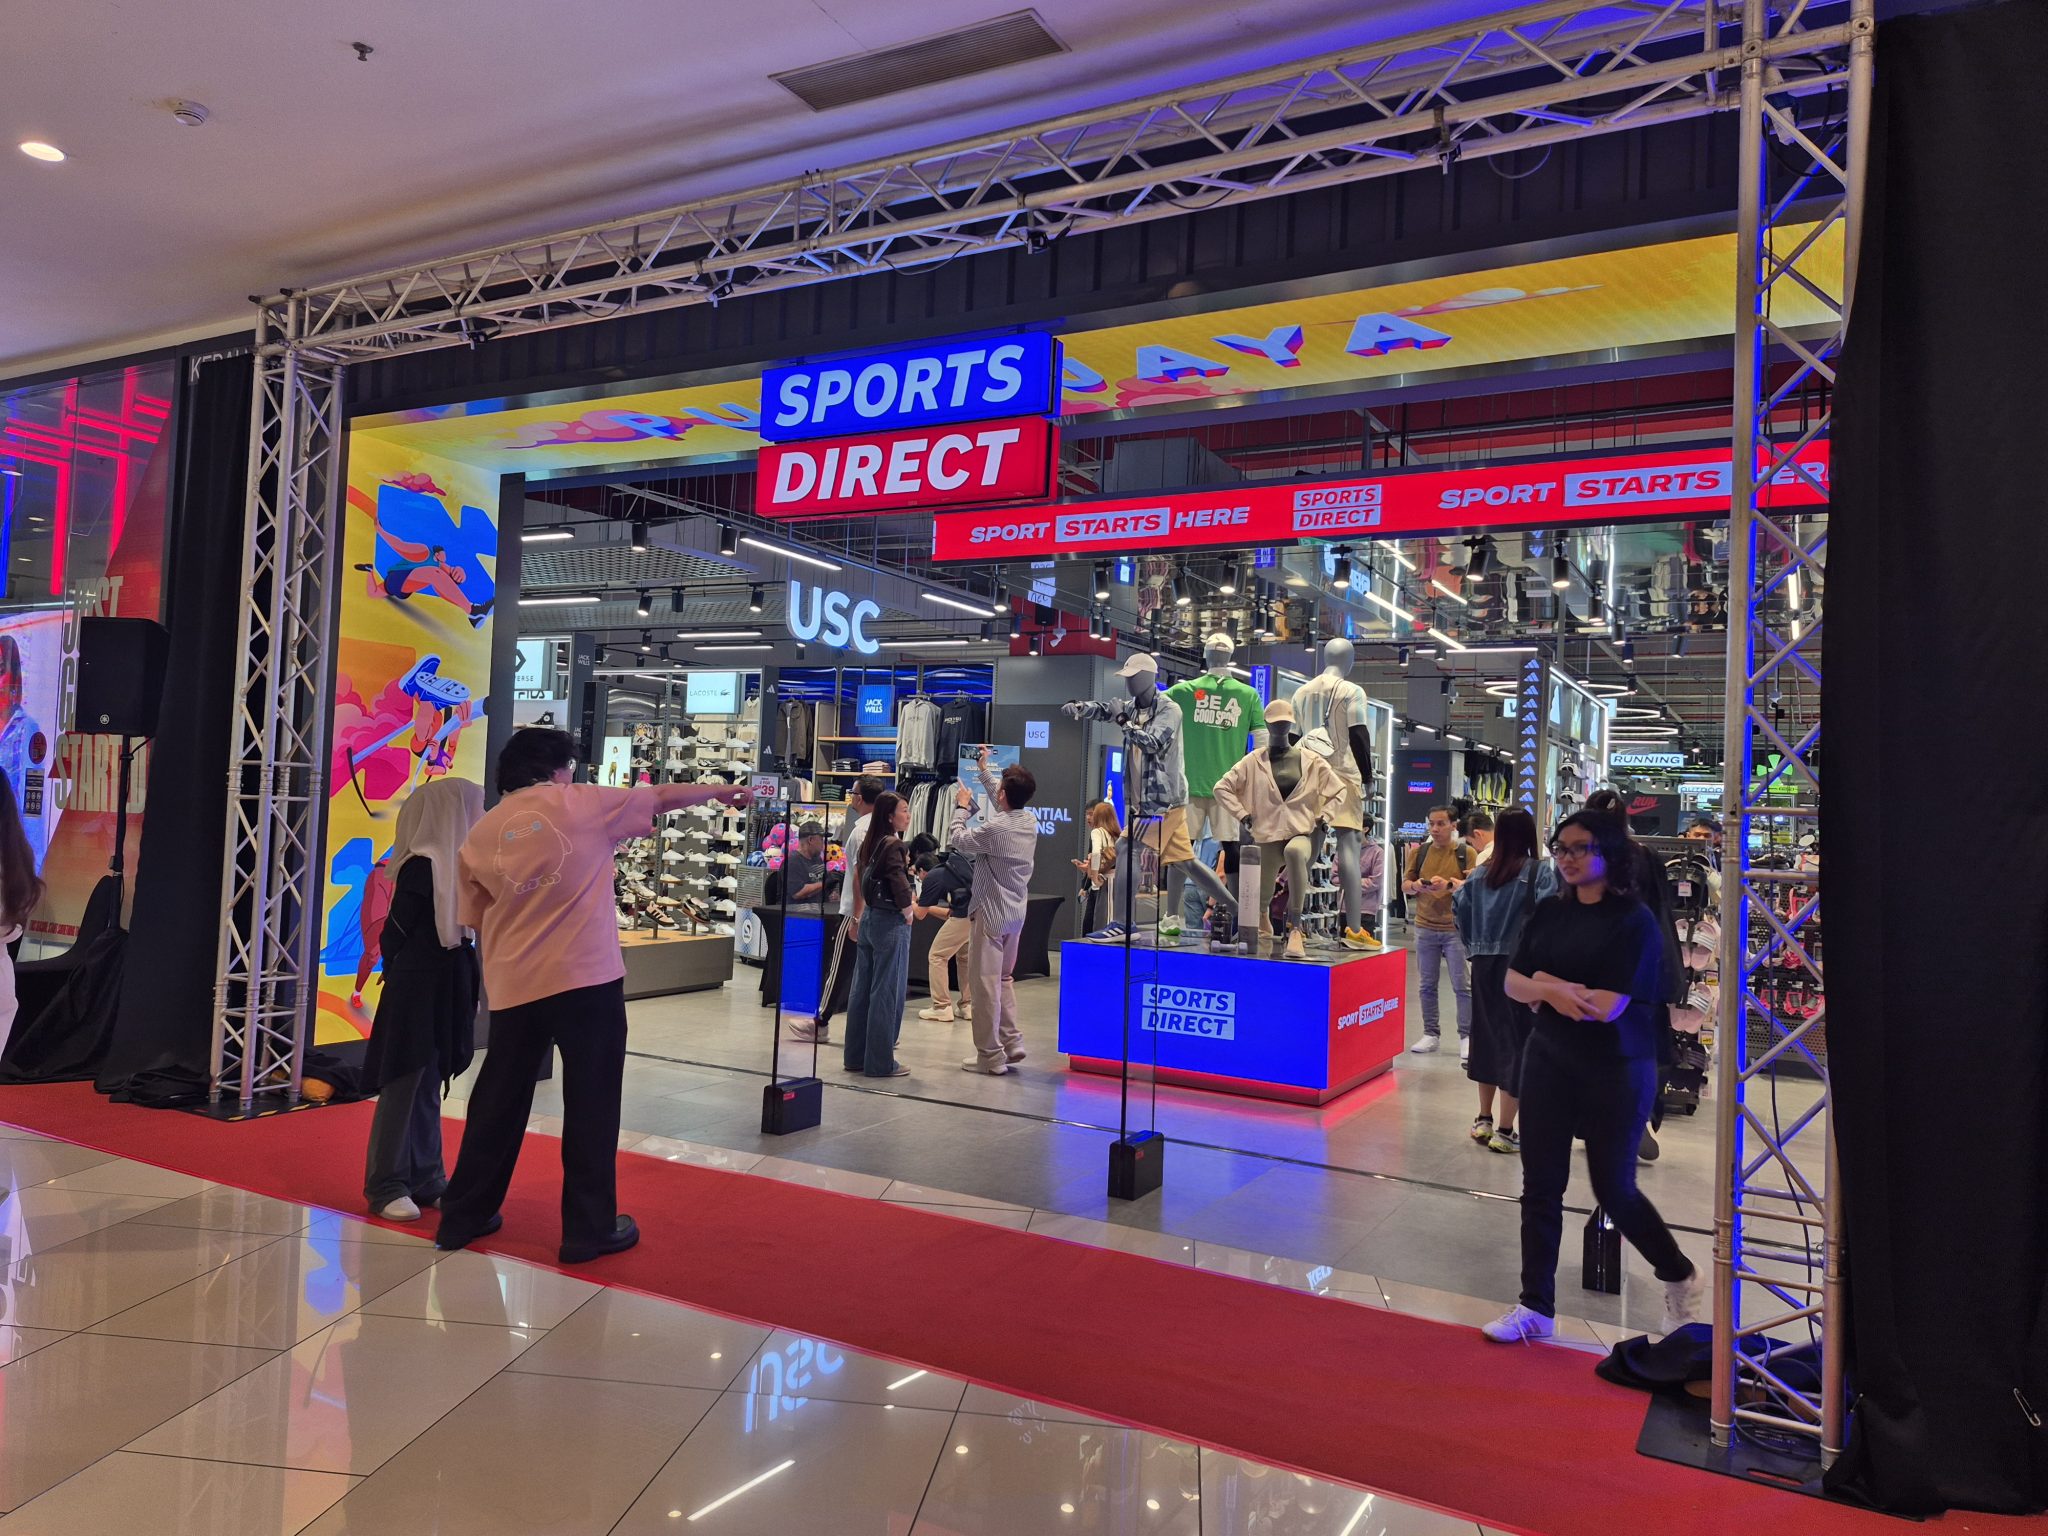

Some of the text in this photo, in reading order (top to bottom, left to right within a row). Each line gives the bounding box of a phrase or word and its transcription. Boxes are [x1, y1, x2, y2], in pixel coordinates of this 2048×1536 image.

[774, 344, 1025, 427] SPORTS
[772, 428, 1020, 504] DIRECT
[1299, 487, 1375, 507] SPORTS
[1438, 482, 1556, 509] SPORT
[1576, 469, 1721, 499] STARTS
[969, 506, 1250, 543] SPORT STARTS HERE
[1299, 508, 1374, 527] DIRECT
[789, 579, 880, 655] USC
[518, 691, 546, 699] FILA
[689, 689, 718, 697] LACOSTE
[865, 698, 882, 707] JACK
[1195, 693, 1241, 712] BE A
[864, 706, 883, 714] WILLS
[1193, 708, 1215, 724] GOOD
[1028, 731, 1046, 739] USC
[1613, 755, 1681, 764] RUNNING
[55, 734, 148, 814] STARTD
[761, 784, 775, 796] 39
[1631, 796, 1658, 807] RUN
[1036, 821, 1055, 835] NS
[1148, 987, 1229, 1011] SPORTS
[1337, 997, 1399, 1030] SPORT STARTS HERE
[1147, 1011, 1228, 1036] DIRECT
